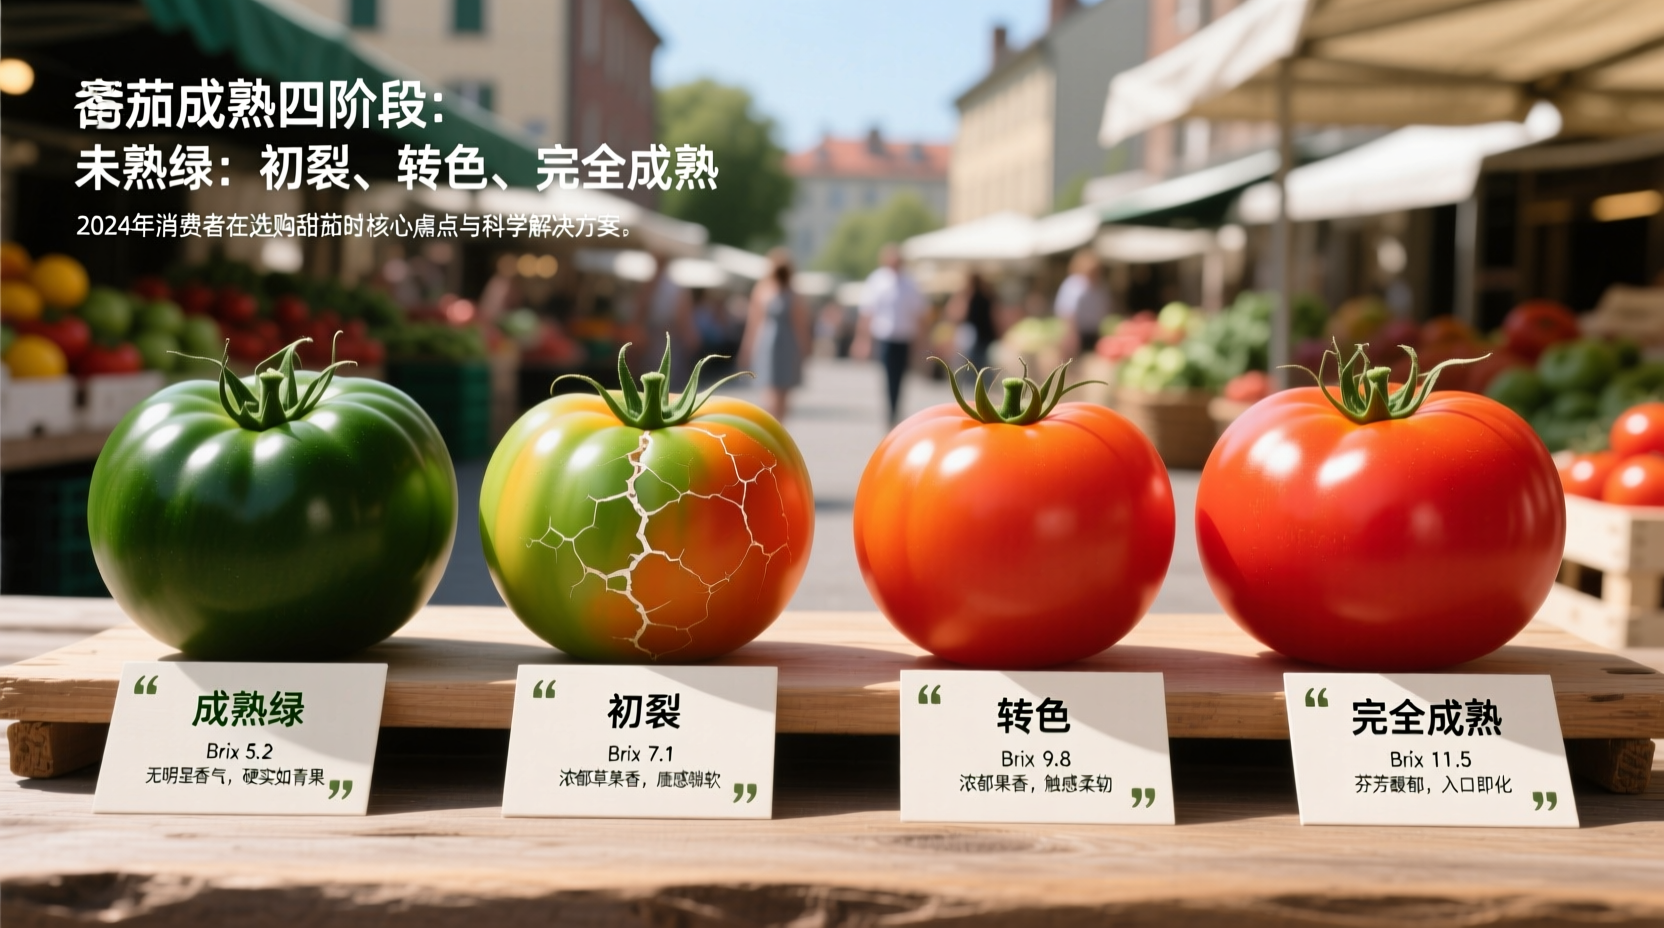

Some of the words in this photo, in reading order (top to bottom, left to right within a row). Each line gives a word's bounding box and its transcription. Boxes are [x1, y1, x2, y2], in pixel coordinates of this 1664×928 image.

[191, 689, 305, 728] 成熟绿
[607, 692, 681, 730] 初裂
[997, 696, 1071, 735] 转色
[1352, 697, 1503, 737] 完全成熟
[206, 742, 240, 760] Brix
[245, 742, 273, 760] 5.2
[608, 745, 641, 762] Brix
[648, 745, 673, 762] 7.1
[1001, 750, 1035, 768] Brix
[1042, 750, 1071, 768] 9.8
[1390, 750, 1424, 768] Brix
[1432, 750, 1472, 768] 11.5
